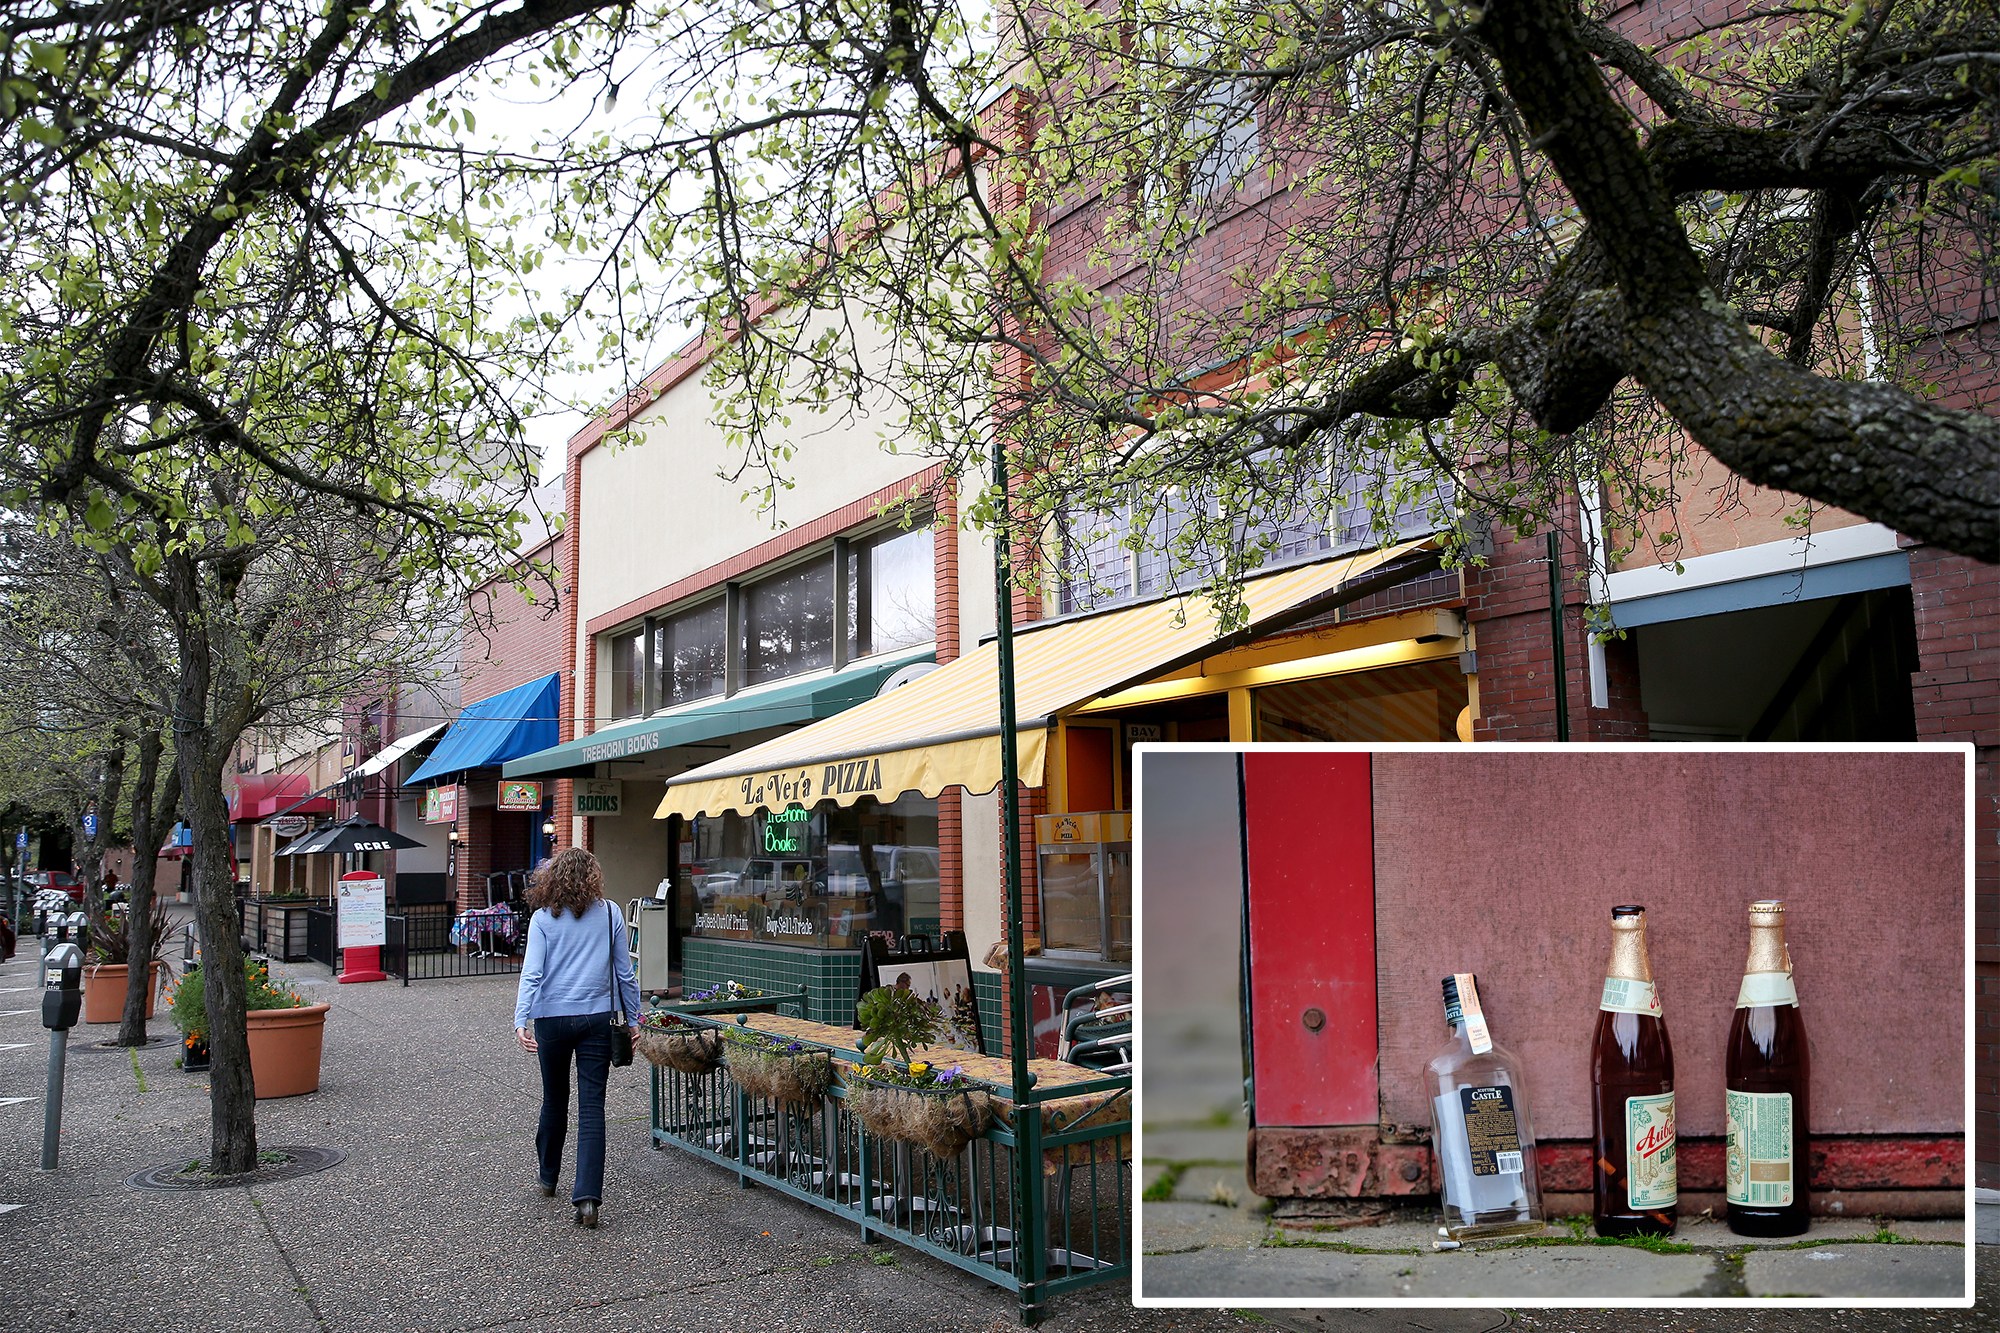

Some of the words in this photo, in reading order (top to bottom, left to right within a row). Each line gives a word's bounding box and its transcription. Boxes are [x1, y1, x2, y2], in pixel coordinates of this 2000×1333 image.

[1131, 727, 1157, 736] BAY
[582, 740, 624, 762] TREEHORN
[627, 732, 659, 754] BOOKS
[741, 777, 764, 805] La
[821, 758, 883, 796] PIZZA
[504, 797, 537, 805] Palomar
[577, 795, 618, 812] BOOKS
[441, 801, 454, 819] food
[84, 815, 93, 827] 3
[19, 833, 25, 842] 3
[765, 825, 797, 852] Books
[353, 841, 392, 851] ACRE
[1471, 1089, 1503, 1101] CASTLE
[1636, 1118, 1675, 1151] Аліва
